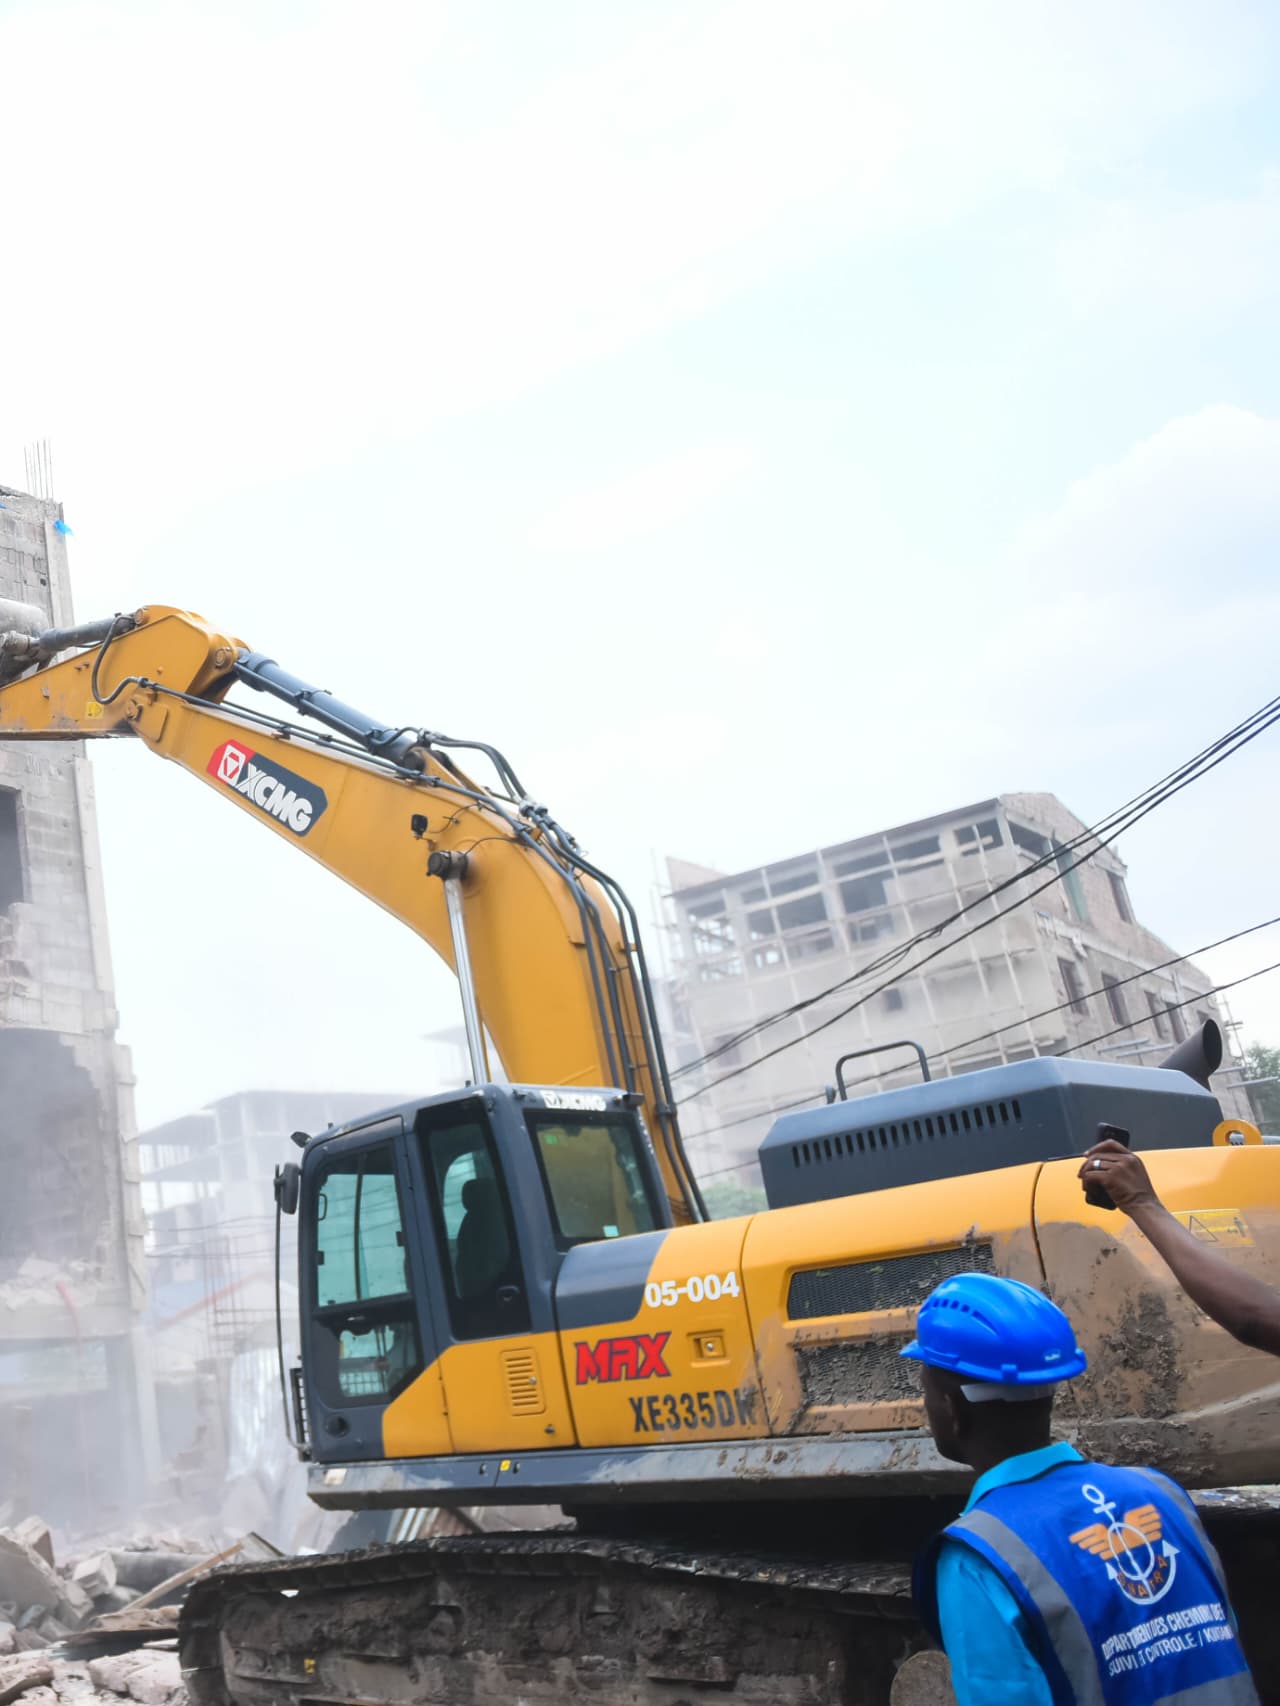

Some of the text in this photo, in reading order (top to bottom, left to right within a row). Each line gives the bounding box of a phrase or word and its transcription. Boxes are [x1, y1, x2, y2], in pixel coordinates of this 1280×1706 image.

[235, 762, 313, 832] XCMG
[645, 1271, 740, 1308] 05-004
[574, 1331, 672, 1385] MAX
